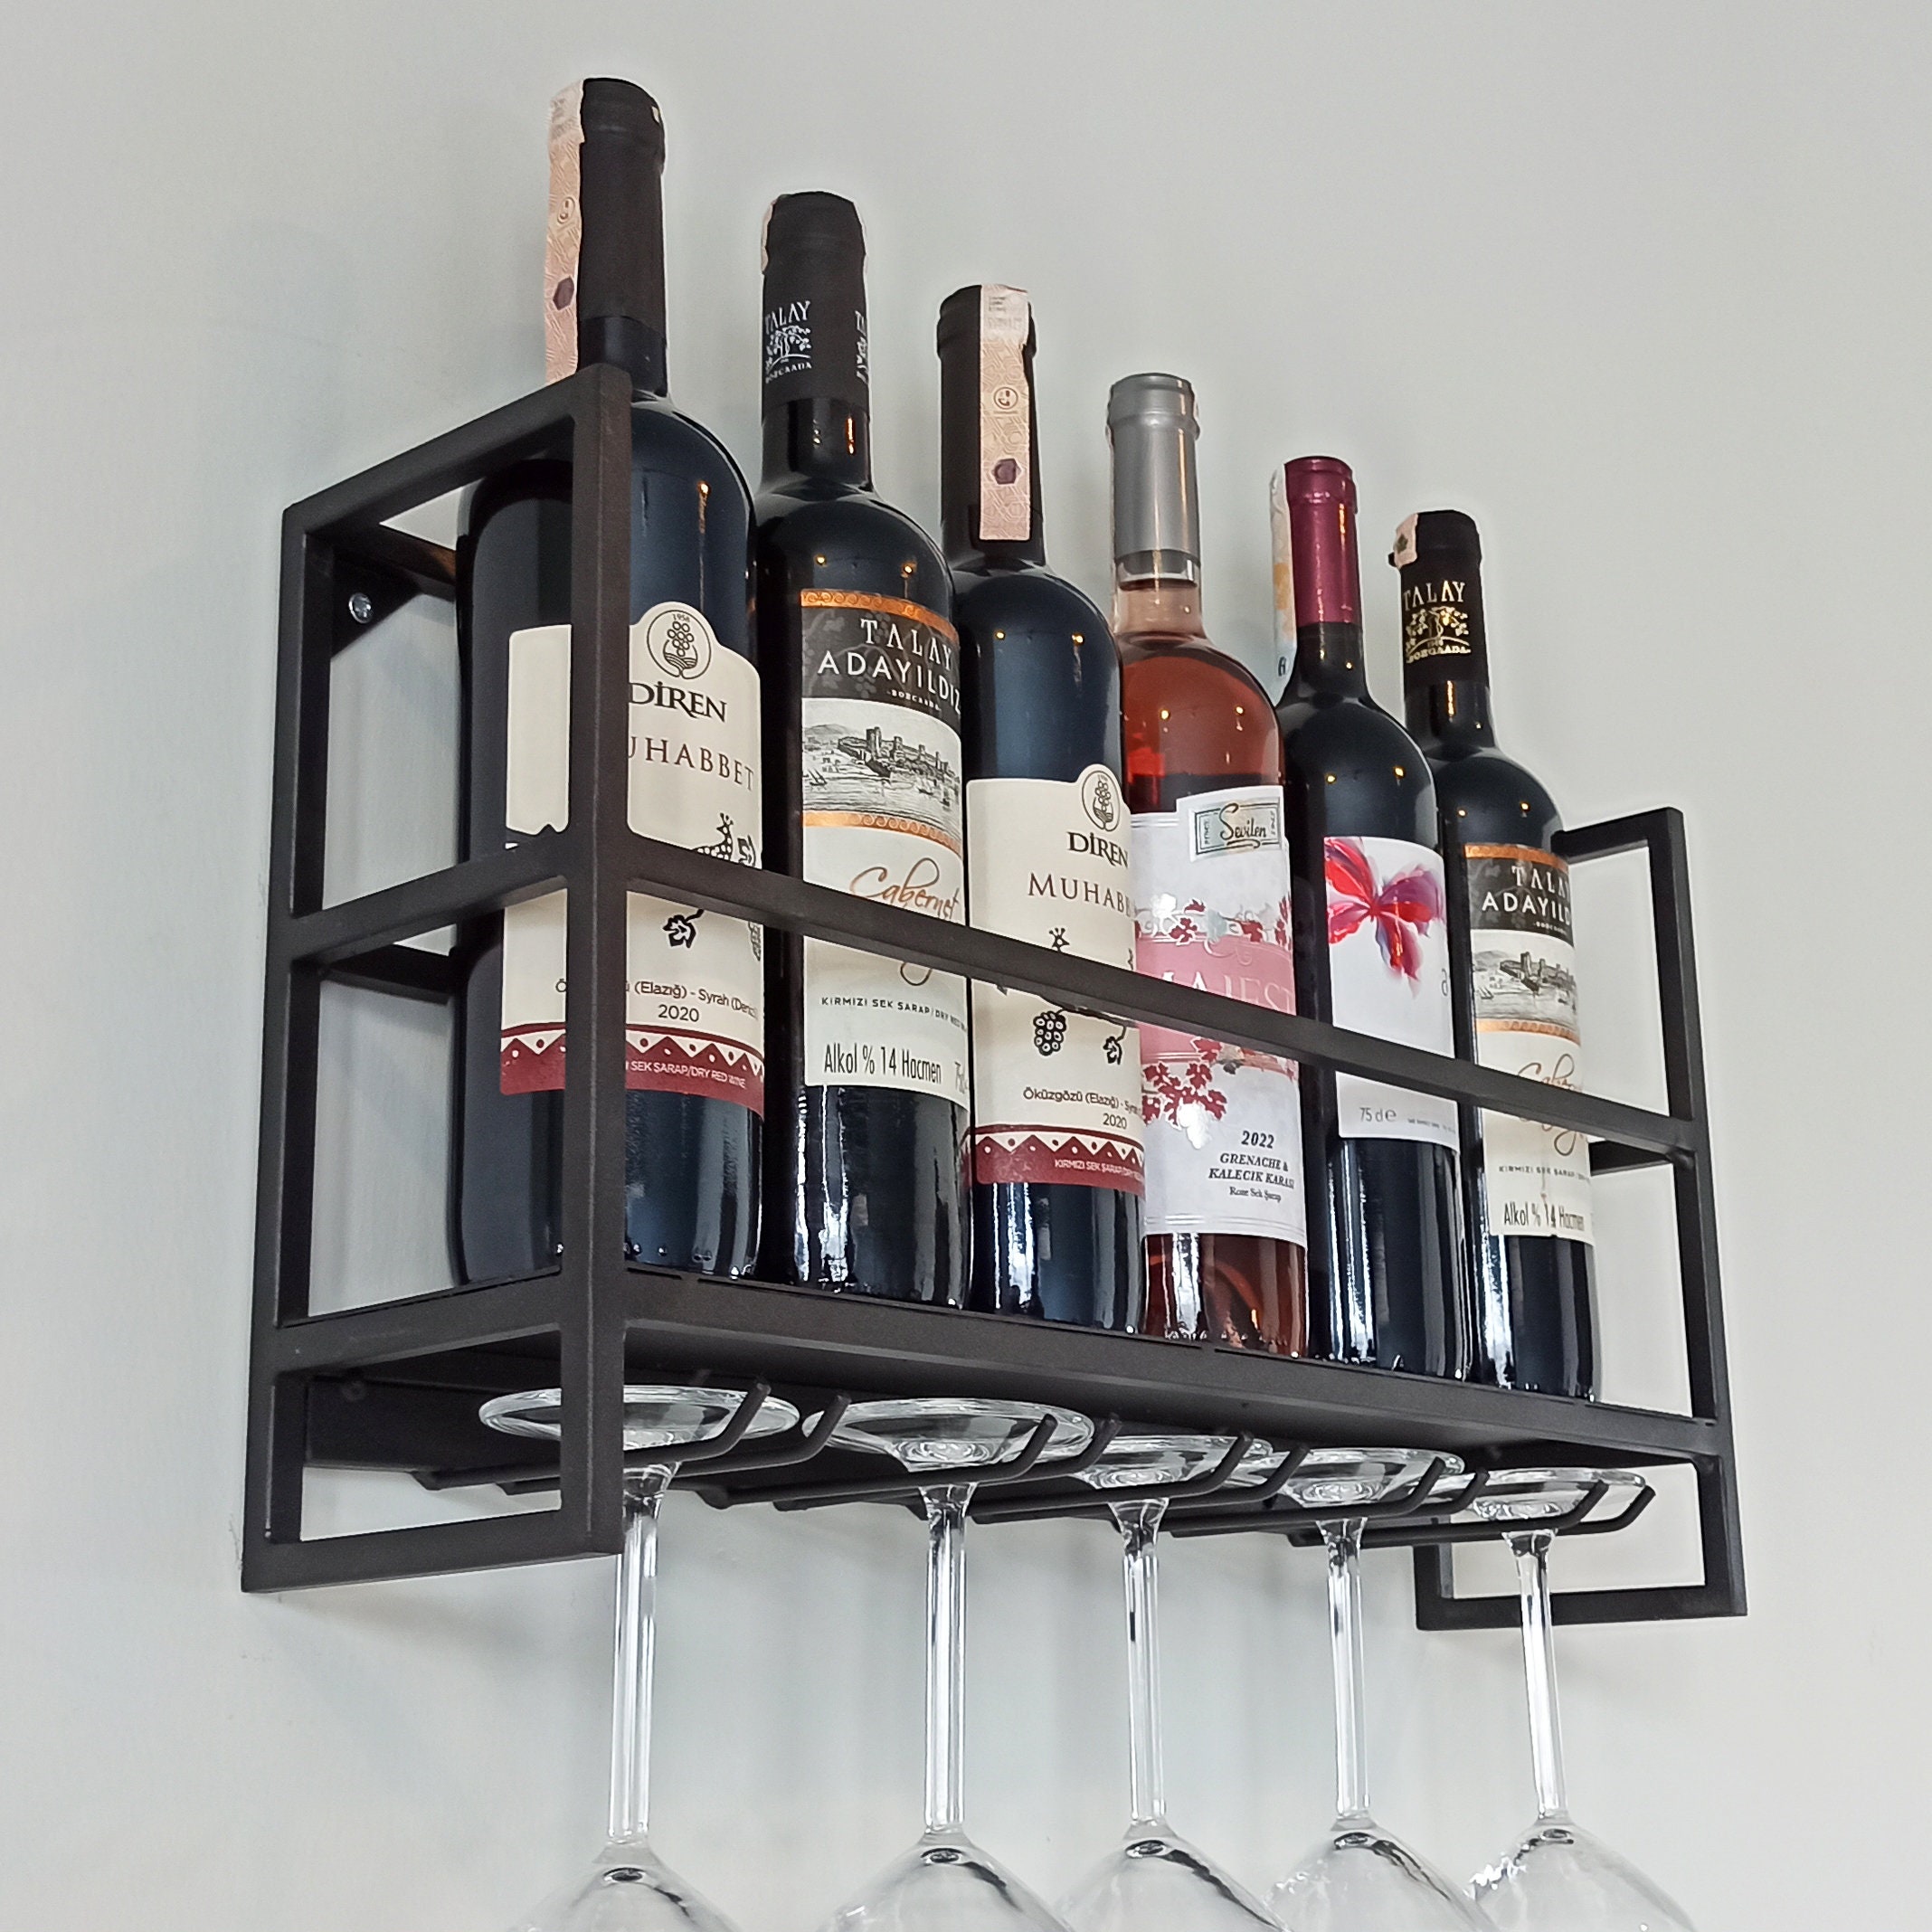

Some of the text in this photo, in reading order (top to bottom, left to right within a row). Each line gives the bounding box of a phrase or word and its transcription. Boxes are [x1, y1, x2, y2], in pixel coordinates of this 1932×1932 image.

[1403, 580, 1465, 611] TALAY
[860, 618, 952, 671] TALAY
[849, 857, 961, 920] Cabernet
[698, 988, 729, 1006] Syrah
[872, 999, 894, 1009] SEK
[658, 1003, 700, 1022] 2020
[630, 1060, 652, 1072] SEK
[824, 1042, 857, 1074] Alkol
[862, 1045, 876, 1075] %
[880, 1046, 897, 1076] 14
[903, 1048, 942, 1085] Hacmen
[1103, 1113, 1128, 1130] 2020
[1241, 1130, 1275, 1150] 2022
[1219, 1152, 1282, 1170] GRENACHE
[1504, 1201, 1530, 1226] Alkol
